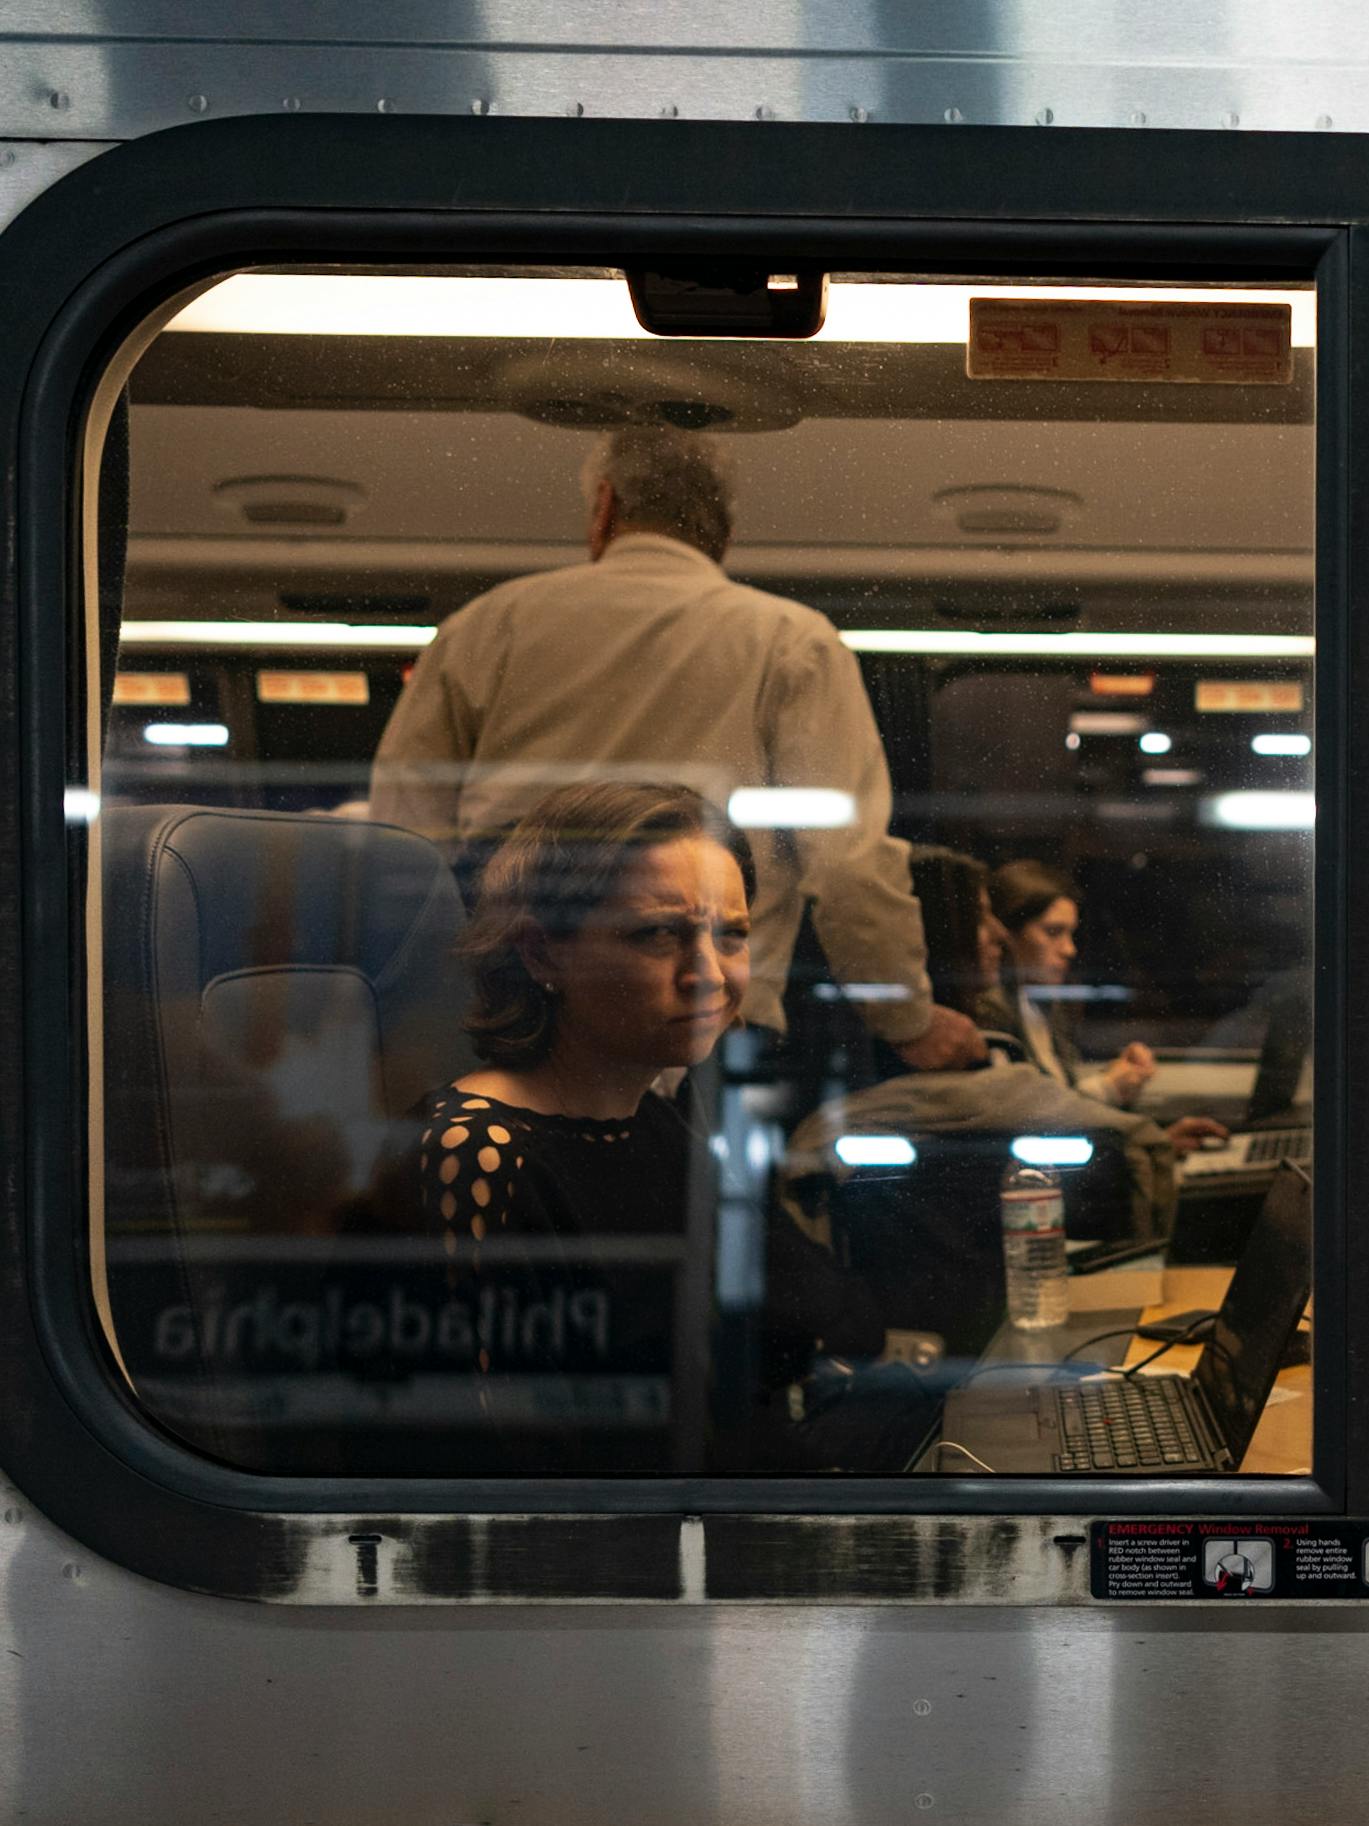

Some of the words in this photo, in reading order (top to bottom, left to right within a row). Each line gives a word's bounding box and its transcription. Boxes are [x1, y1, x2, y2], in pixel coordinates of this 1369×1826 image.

[1108, 1524, 1194, 1534] EMERGENCY
[1198, 1524, 1252, 1534] Window
[1255, 1524, 1308, 1534] Removal
[1296, 1539, 1316, 1548] Using
[1122, 1564, 1140, 1572] body
[1142, 1564, 1152, 1572] (as
[1312, 1564, 1320, 1572] by
[1322, 1564, 1348, 1572] pulling
[1108, 1572, 1154, 1580] cross-section
[1308, 1572, 1322, 1580] and
[1108, 1580, 1120, 1588] Pry
[1122, 1580, 1143, 1588] down
[1144, 1580, 1158, 1588] and
[1160, 1580, 1192, 1588] outward
[1148, 1588, 1177, 1596] window
